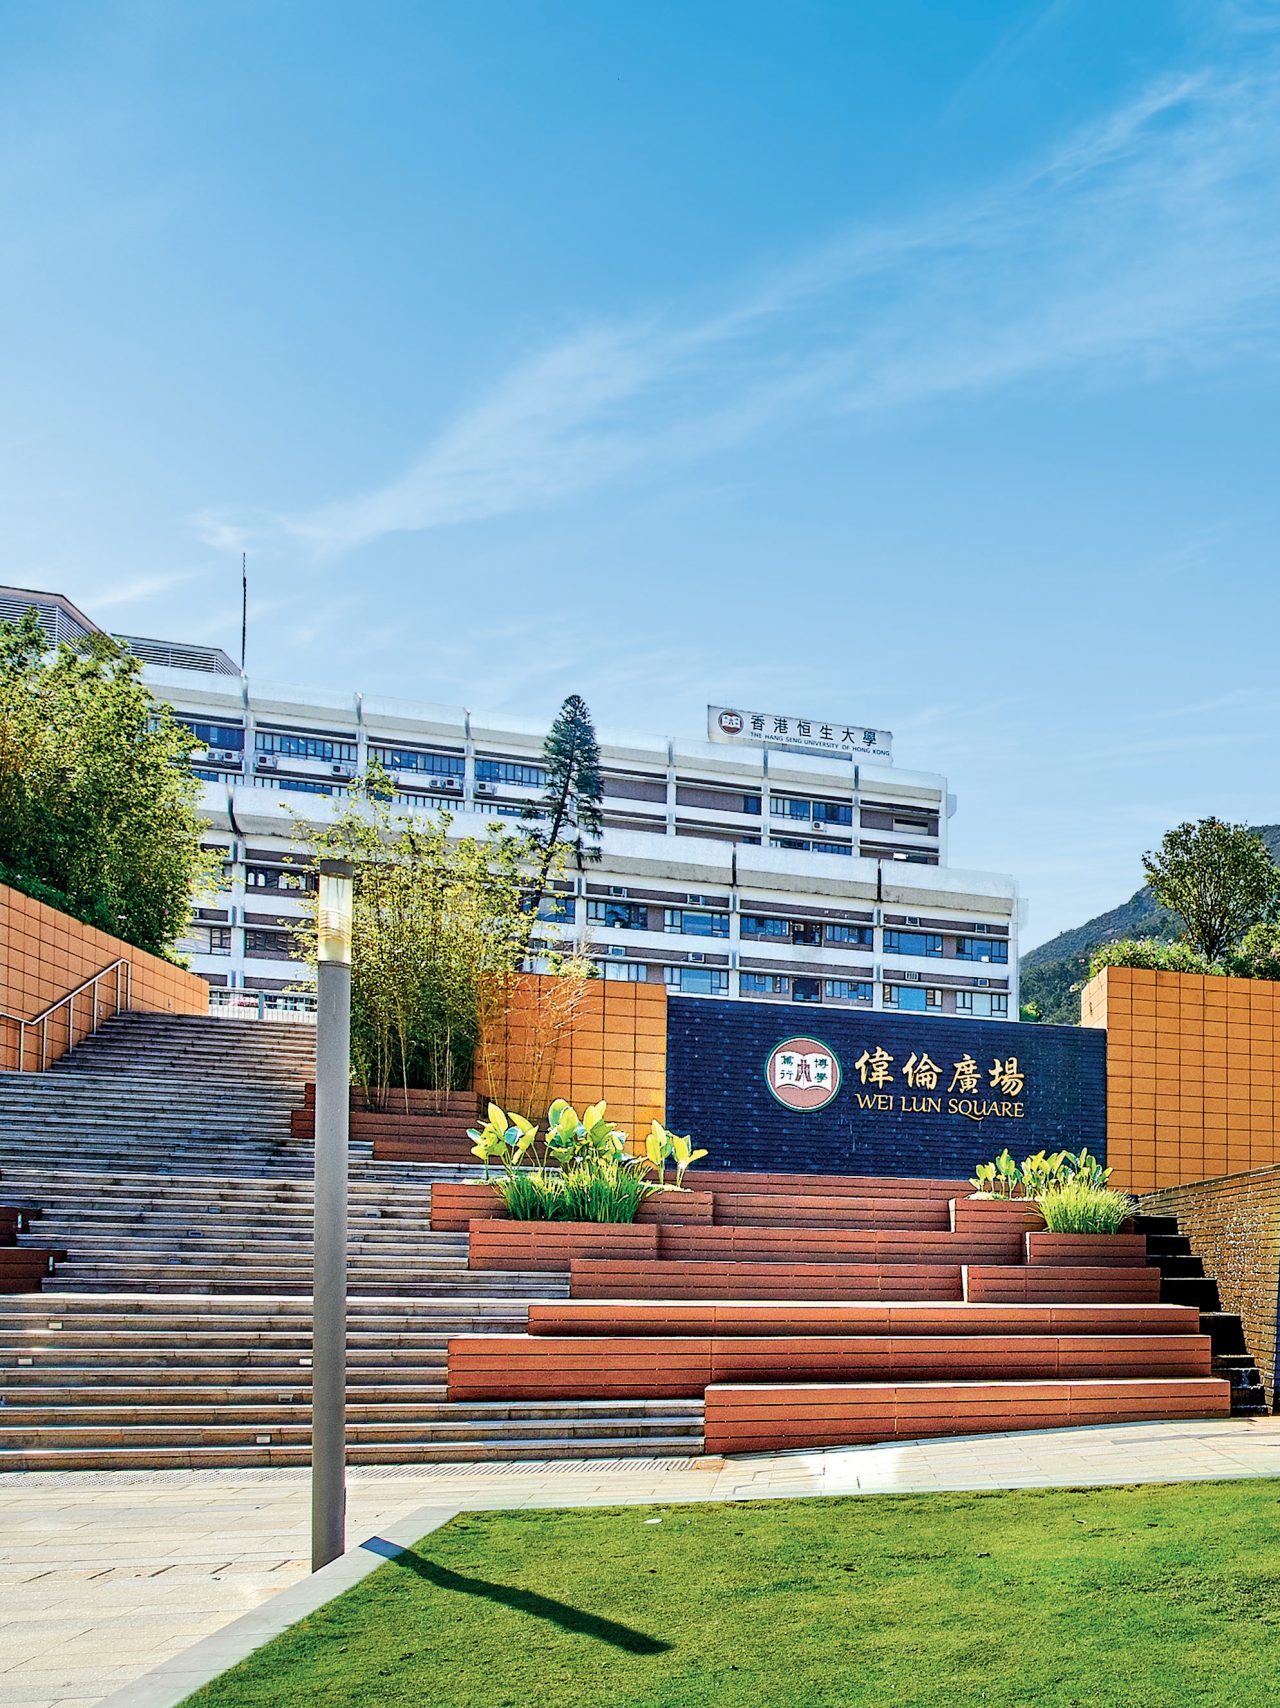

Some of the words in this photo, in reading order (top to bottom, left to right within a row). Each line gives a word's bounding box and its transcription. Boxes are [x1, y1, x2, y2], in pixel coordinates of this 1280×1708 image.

[750, 731, 762, 739] THE
[764, 734, 784, 742] HANG
[785, 736, 803, 744] SENG
[803, 738, 839, 750] UNIVERSITY
[852, 746, 871, 754] HONG
[872, 749, 890, 757] KONG
[751, 715, 877, 746] 香港恒生大學
[854, 1046, 1025, 1097] 偉倫廣場
[854, 1093, 893, 1110] WEI
[900, 1095, 942, 1113] LUN
[948, 1098, 1025, 1121] SQUARE
